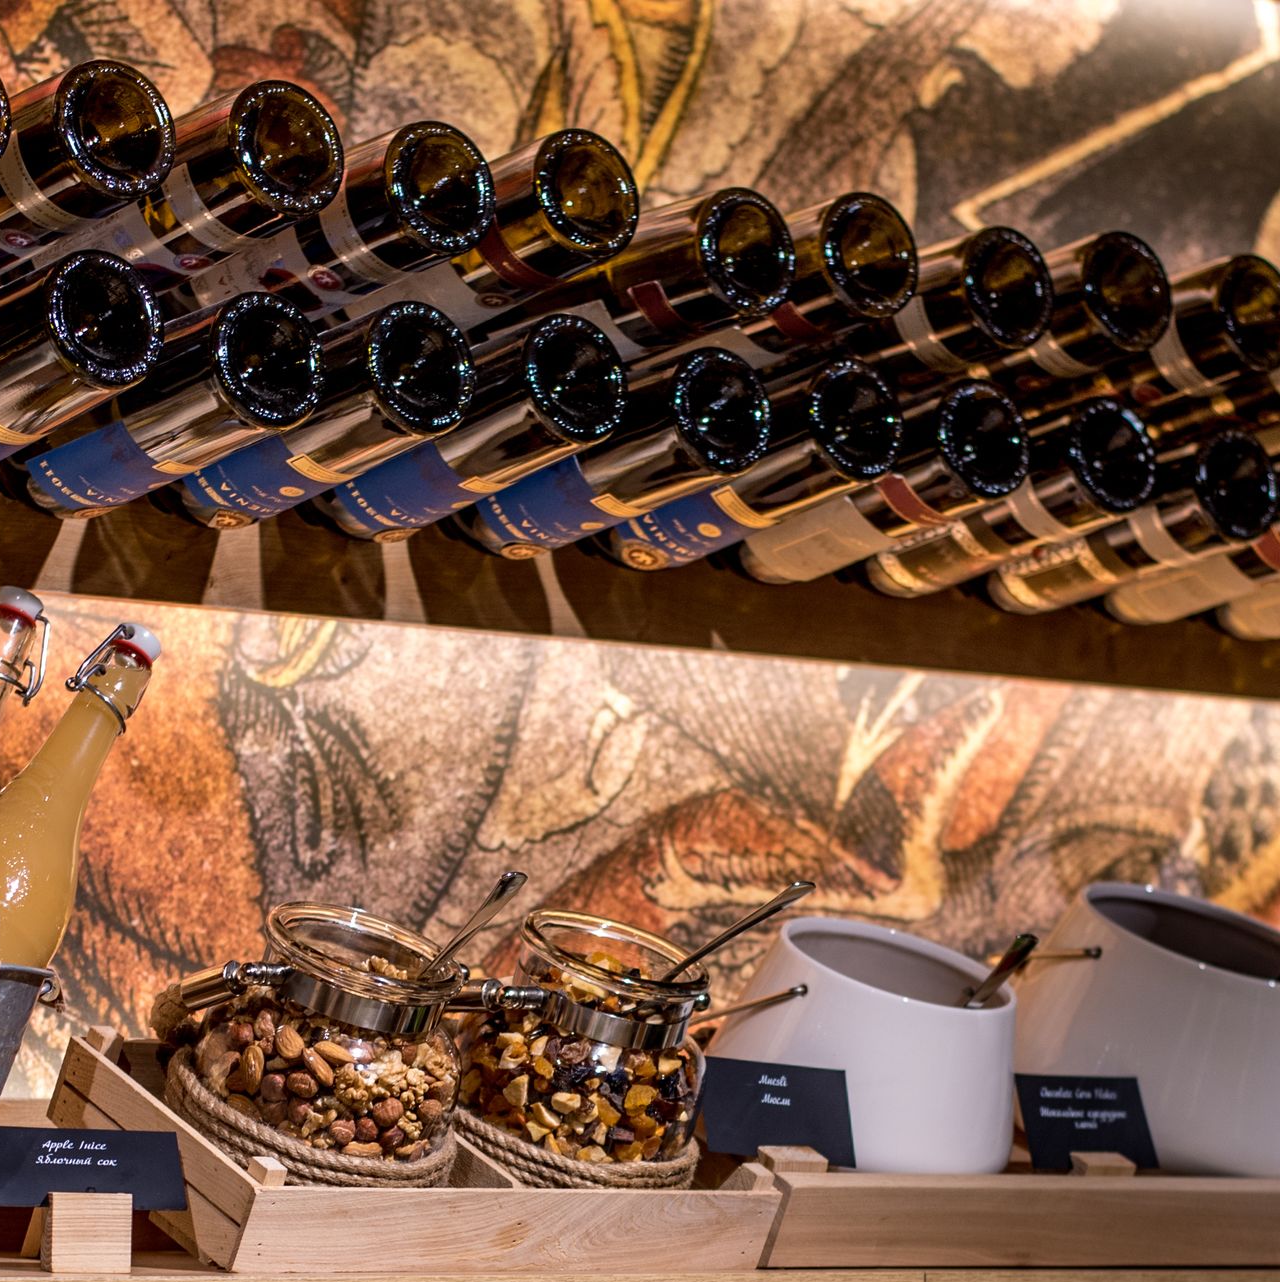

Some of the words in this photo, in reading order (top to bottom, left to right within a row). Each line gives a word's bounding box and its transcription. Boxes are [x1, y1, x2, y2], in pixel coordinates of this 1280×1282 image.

[761, 1093, 791, 1106] Мюсли
[42, 1140, 75, 1153] Apple
[35, 1152, 92, 1165] Яблочный
[97, 1158, 118, 1167] сок
